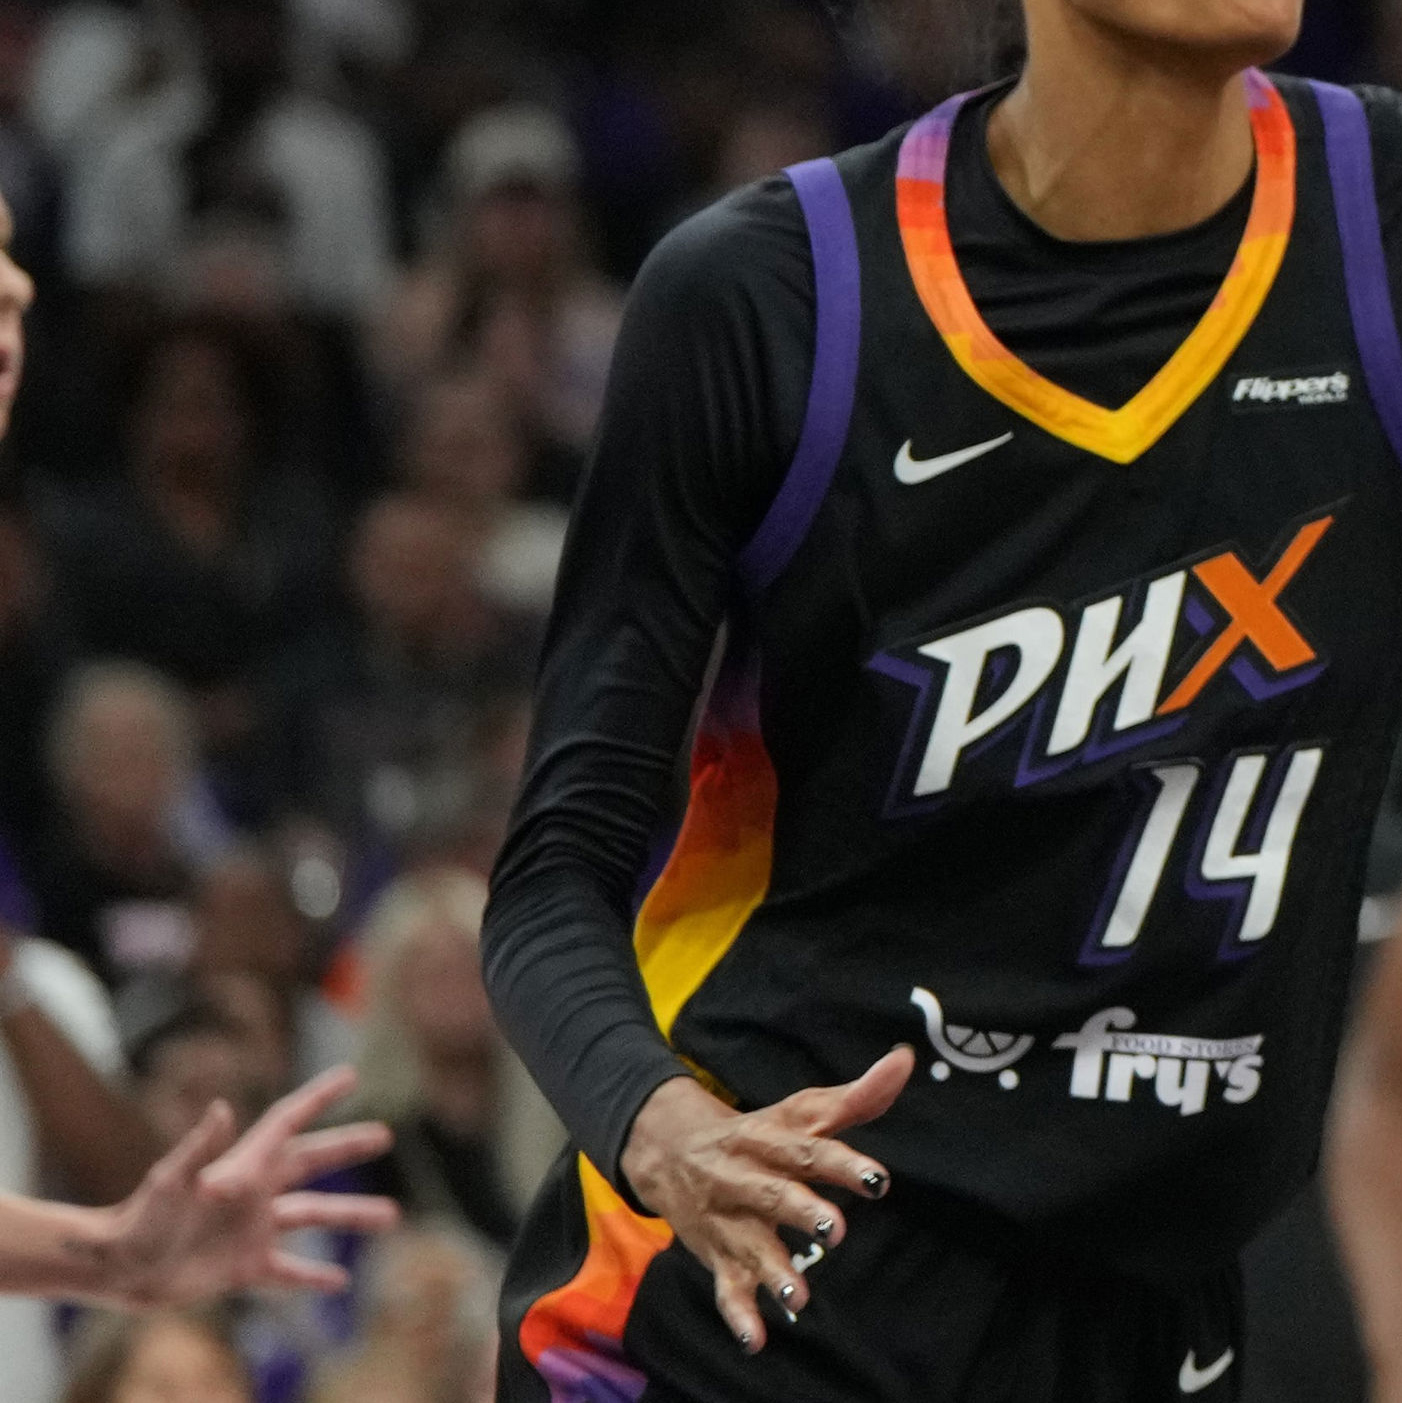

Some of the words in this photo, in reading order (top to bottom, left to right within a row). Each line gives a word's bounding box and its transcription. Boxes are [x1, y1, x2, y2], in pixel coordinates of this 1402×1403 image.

[917, 515, 1335, 796] PHX
[1101, 746, 1324, 947] 14
[1052, 1006, 1264, 1116] fry's
[1110, 1035, 1173, 1054] FOOD
[1180, 1038, 1256, 1057] STORES
